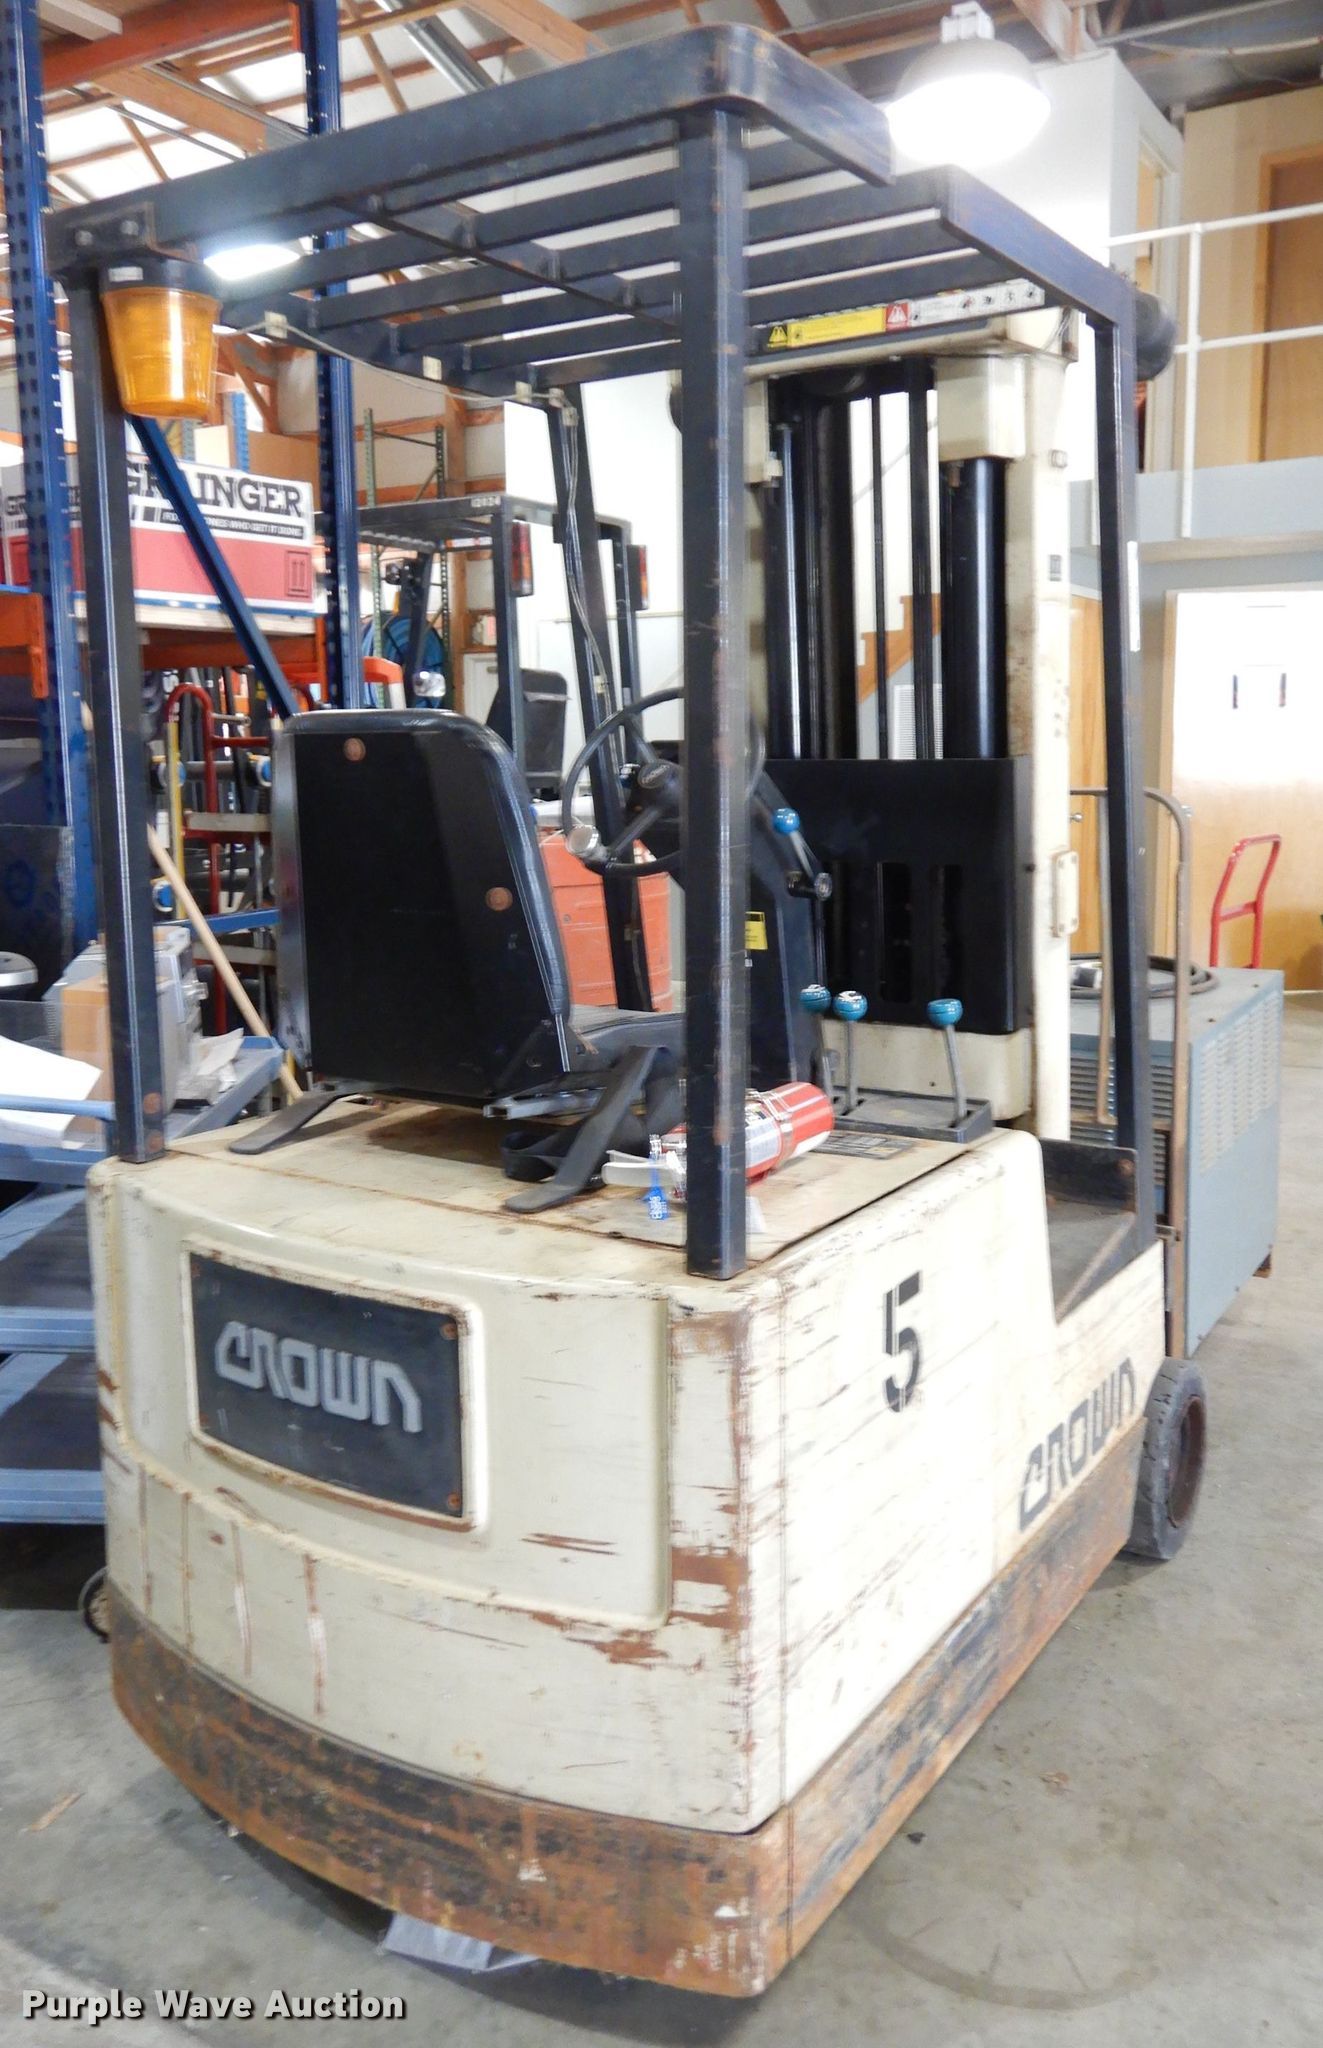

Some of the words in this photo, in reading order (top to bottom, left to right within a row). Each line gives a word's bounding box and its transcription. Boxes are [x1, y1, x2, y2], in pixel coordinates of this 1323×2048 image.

[215, 1320, 423, 1432] CROWN
[883, 1270, 921, 1412] 5
[1018, 1357, 1136, 1533] CROWN
